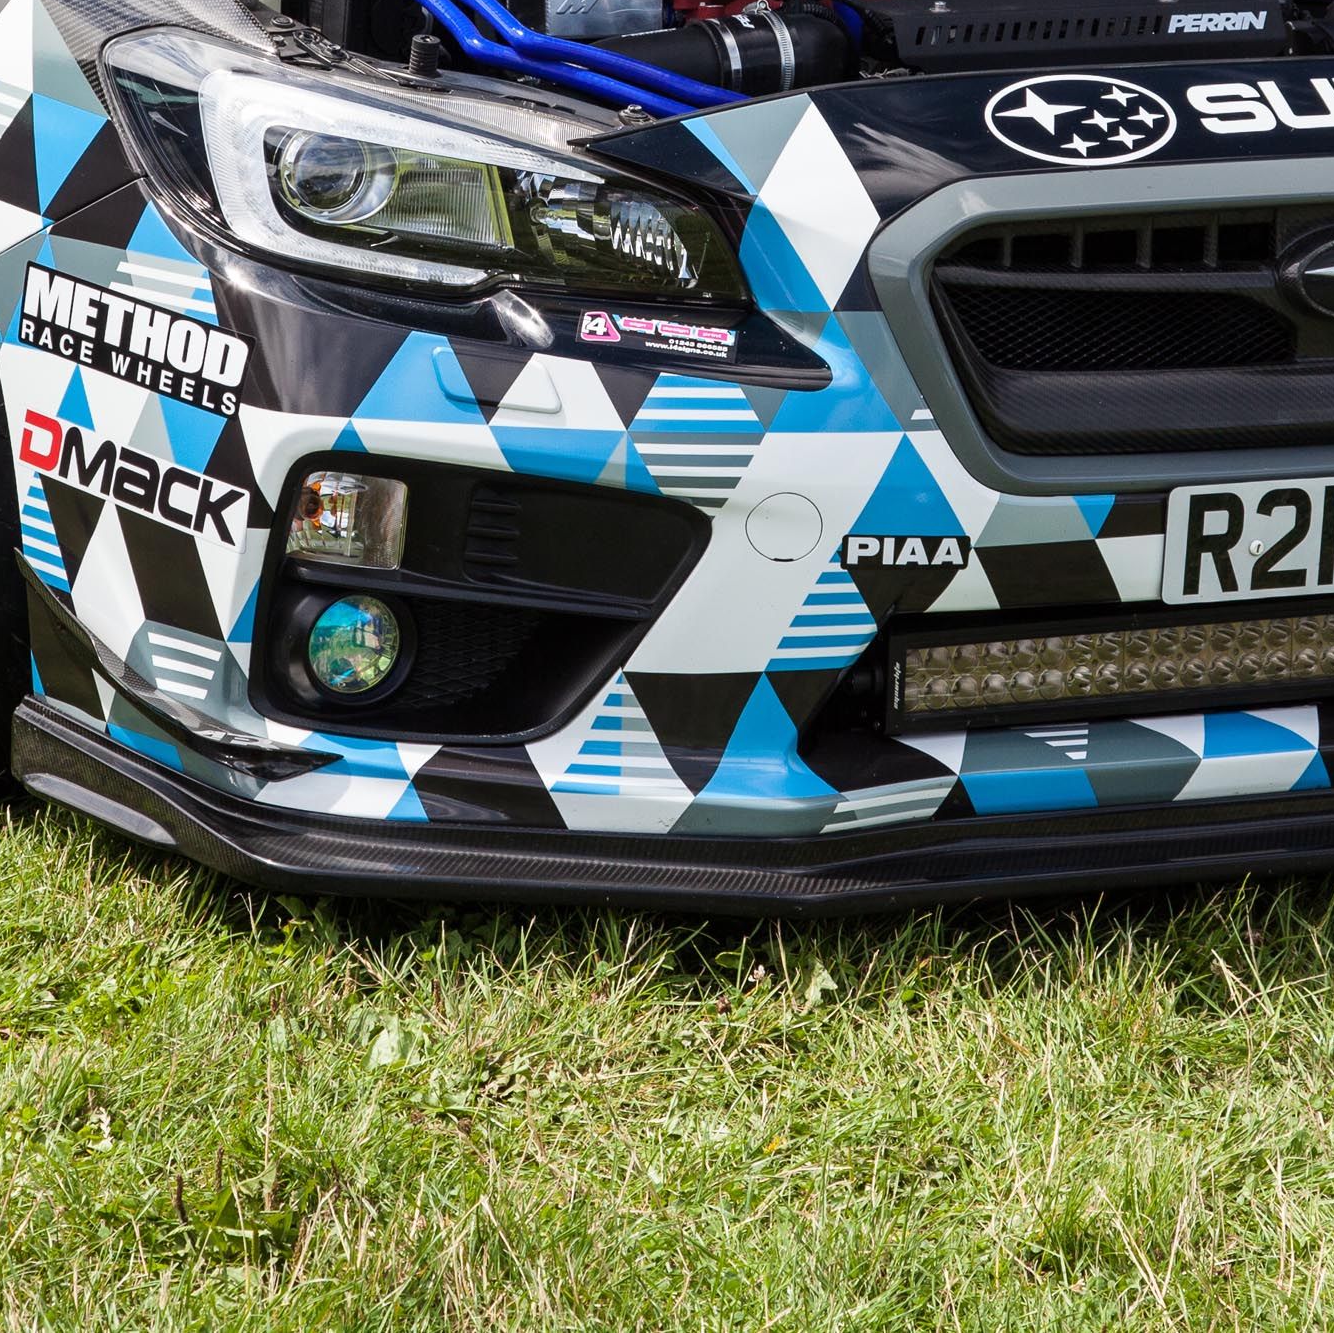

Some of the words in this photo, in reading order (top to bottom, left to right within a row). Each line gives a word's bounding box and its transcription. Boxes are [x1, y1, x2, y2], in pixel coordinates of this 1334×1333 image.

[1168, 11, 1268, 34] PERRIN
[23, 265, 250, 388] METHOD
[20, 318, 94, 365] RACE
[110, 351, 238, 417] WHEELS
[846, 536, 965, 566] PIAA
